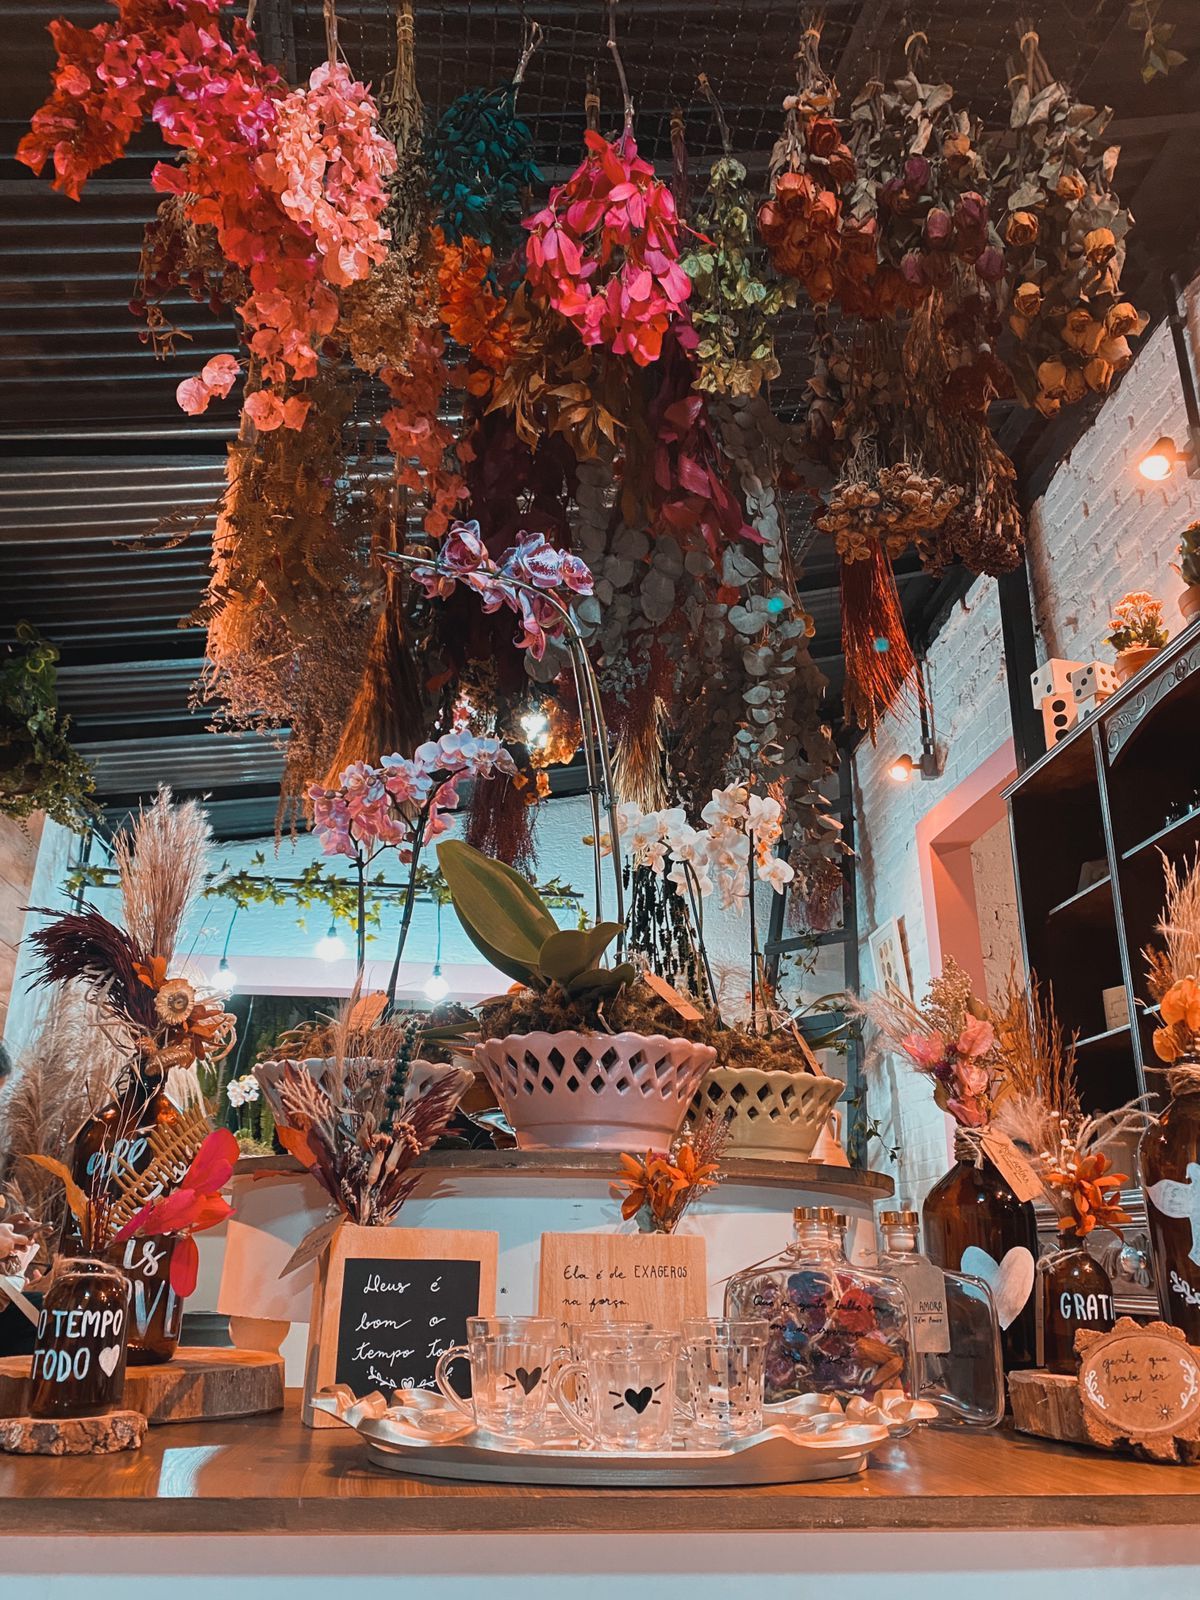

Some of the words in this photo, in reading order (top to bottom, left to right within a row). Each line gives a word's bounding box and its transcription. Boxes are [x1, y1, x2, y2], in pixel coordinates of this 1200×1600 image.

[123, 1239, 167, 1277] is
[564, 1265, 590, 1280] Ela
[609, 1266, 626, 1279] de
[634, 1265, 688, 1279] EXAGEROS
[363, 1274, 411, 1294] Deus
[430, 1276, 442, 1292] é
[562, 1298, 582, 1306] na
[355, 1312, 412, 1331] bom
[32, 1347, 90, 1382] TODO
[352, 1341, 415, 1367] tempo
[1102, 1350, 1137, 1374] gente
